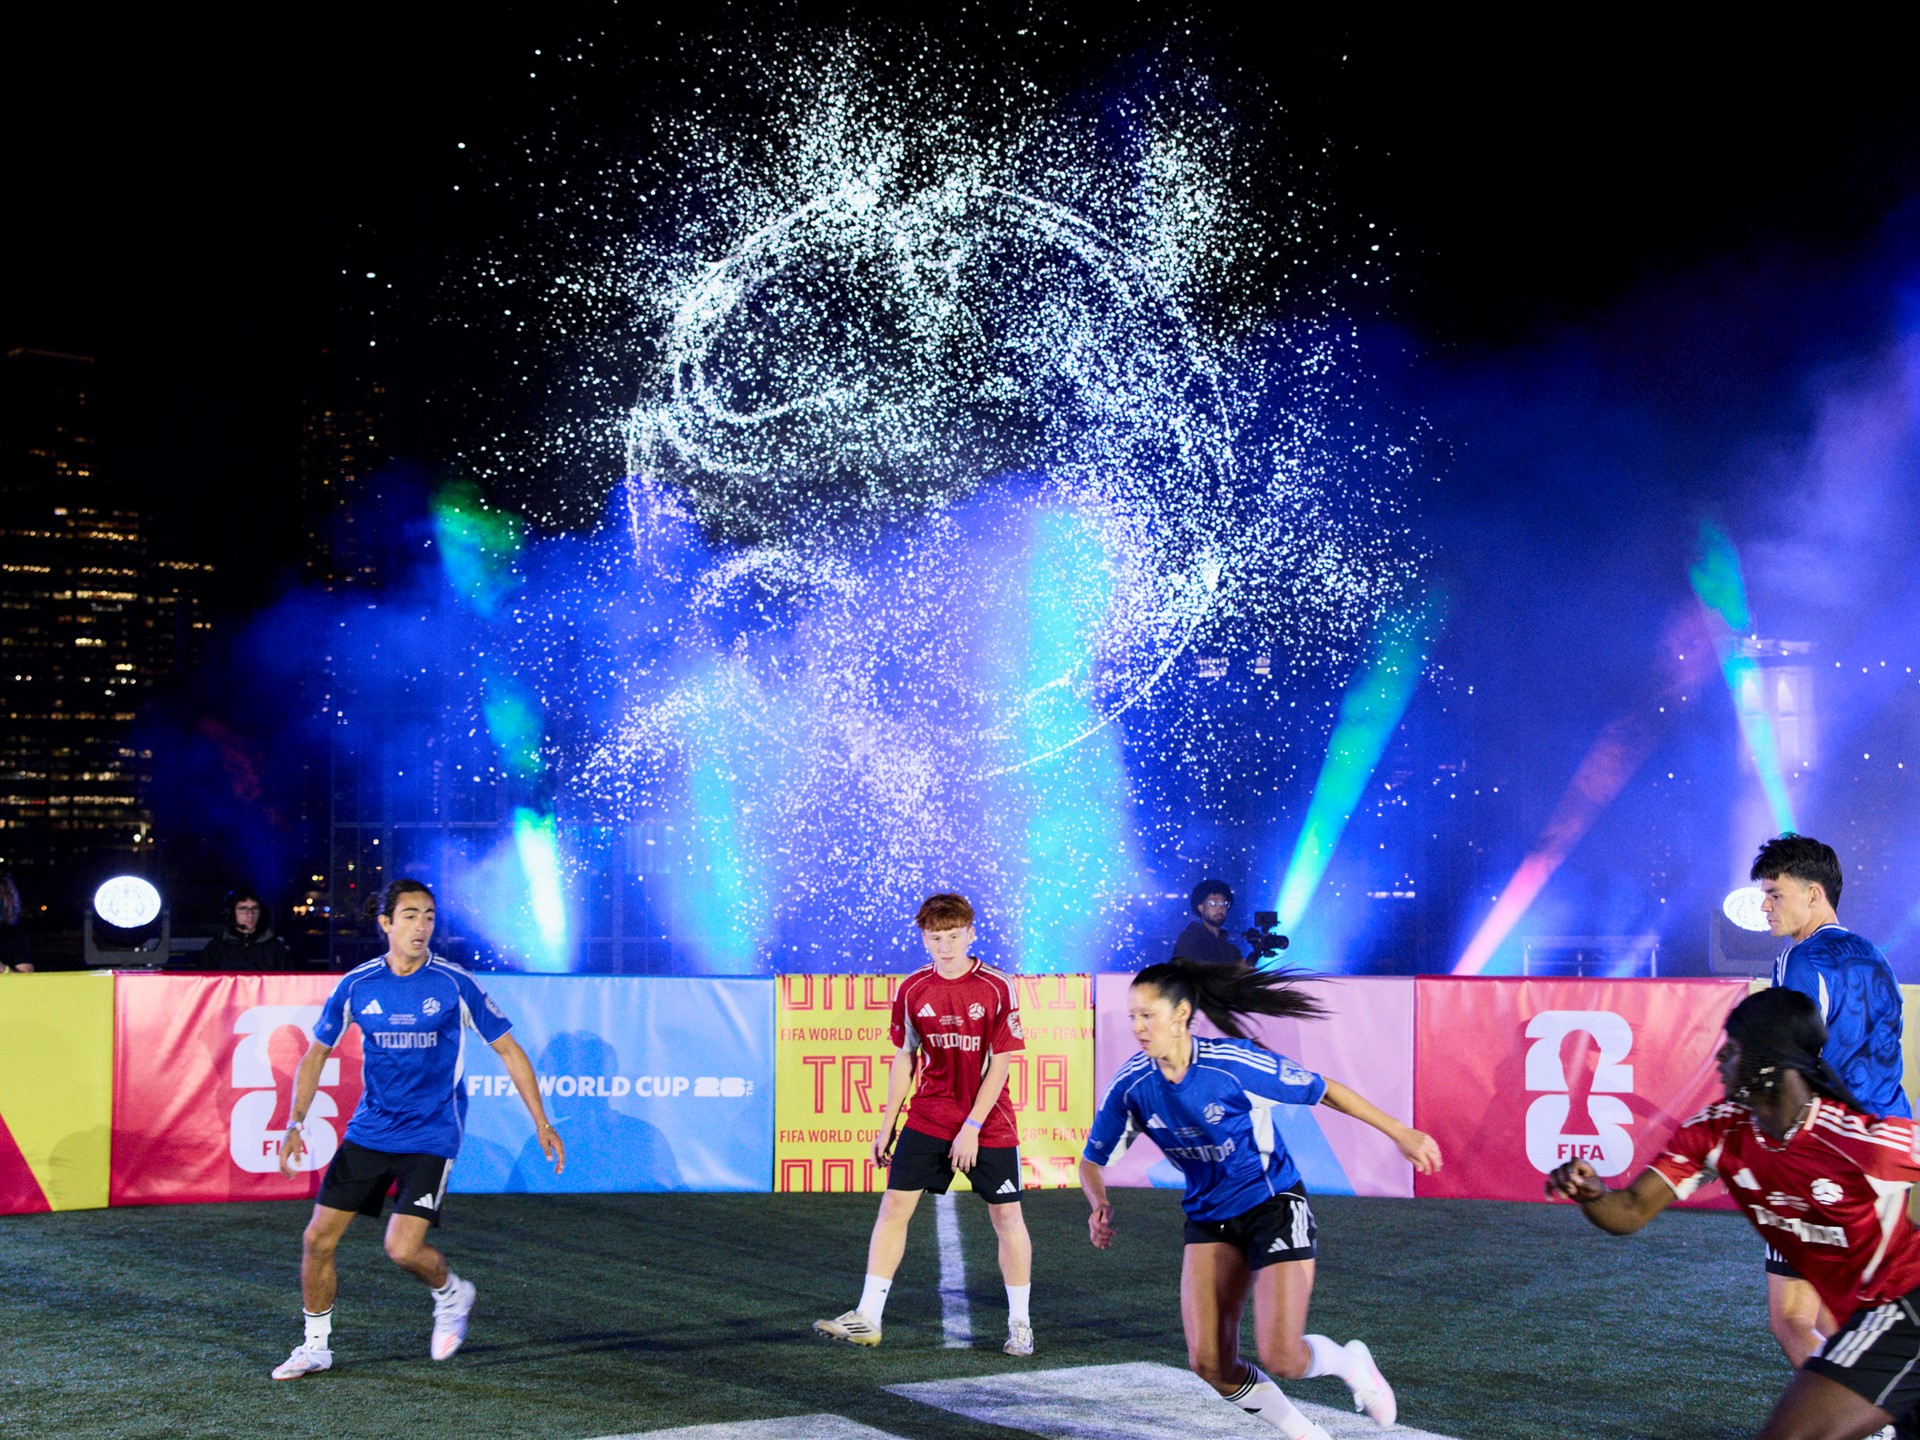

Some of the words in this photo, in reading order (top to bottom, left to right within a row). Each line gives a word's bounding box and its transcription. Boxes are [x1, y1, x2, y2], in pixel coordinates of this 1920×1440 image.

[374, 1031, 438, 1049] TRIONDA
[780, 1028, 806, 1041] FIFA
[811, 1028, 853, 1041] WORLD
[857, 1028, 882, 1041] CUP
[1052, 1027, 1077, 1040] FIFA
[536, 1075, 631, 1098] WORLD
[635, 1075, 689, 1098] CUP
[780, 1129, 805, 1143] FIFA
[808, 1129, 852, 1143] WORLD
[1052, 1127, 1077, 1141] FIFA
[1557, 1143, 1605, 1161] FIFA
